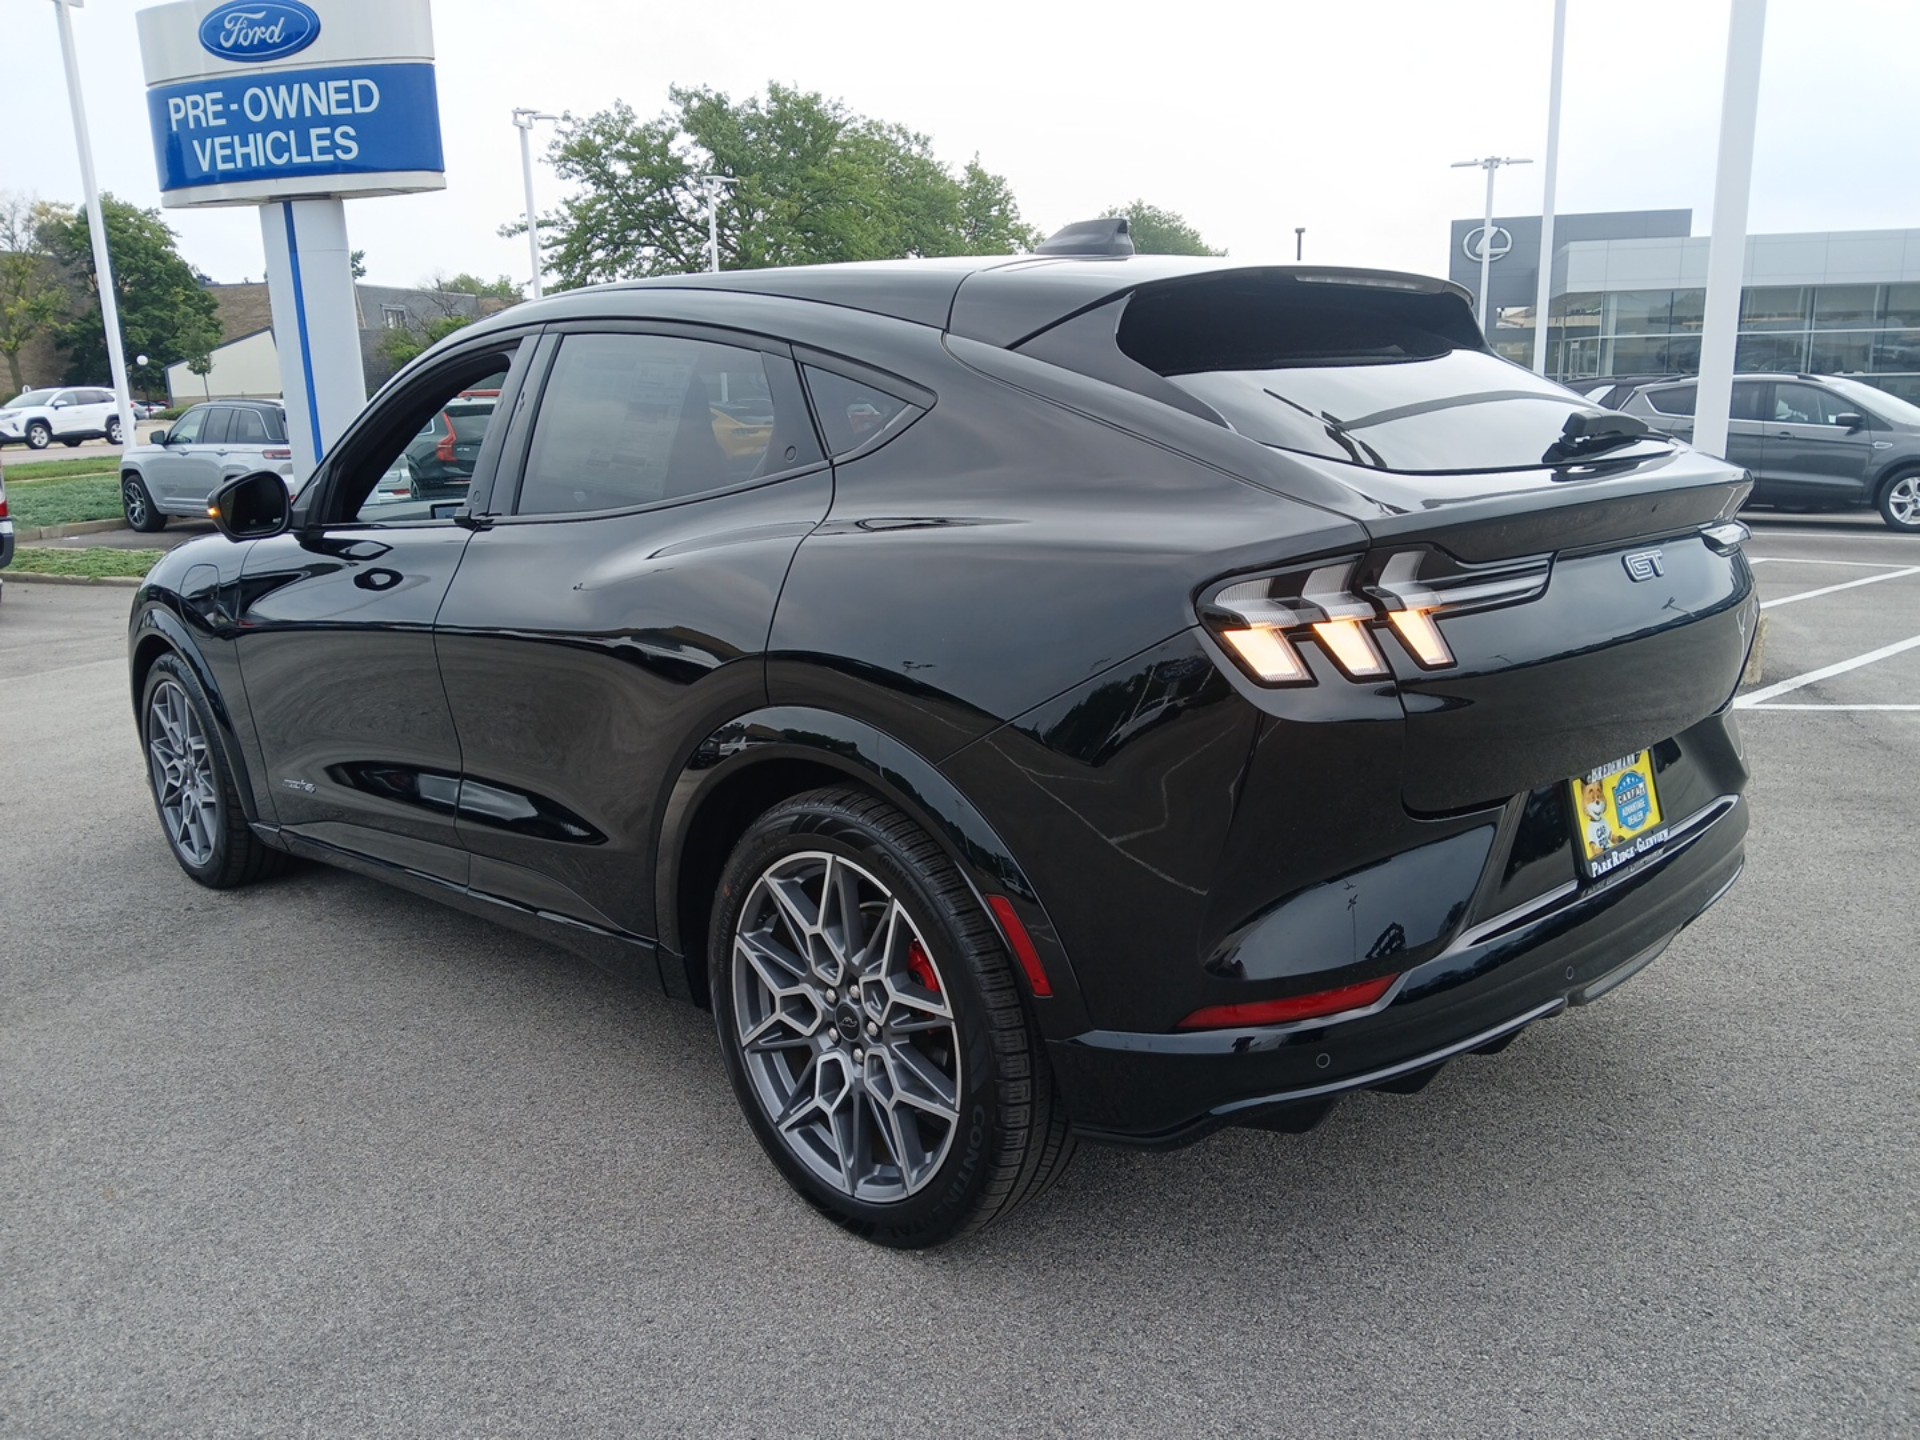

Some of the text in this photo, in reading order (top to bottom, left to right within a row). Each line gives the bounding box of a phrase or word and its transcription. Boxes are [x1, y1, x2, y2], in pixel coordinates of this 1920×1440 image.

[219, 10, 286, 48] Ford
[168, 79, 381, 131] PRE-OWNED
[192, 125, 360, 172] VEHICLES
[1621, 549, 1664, 583] GT
